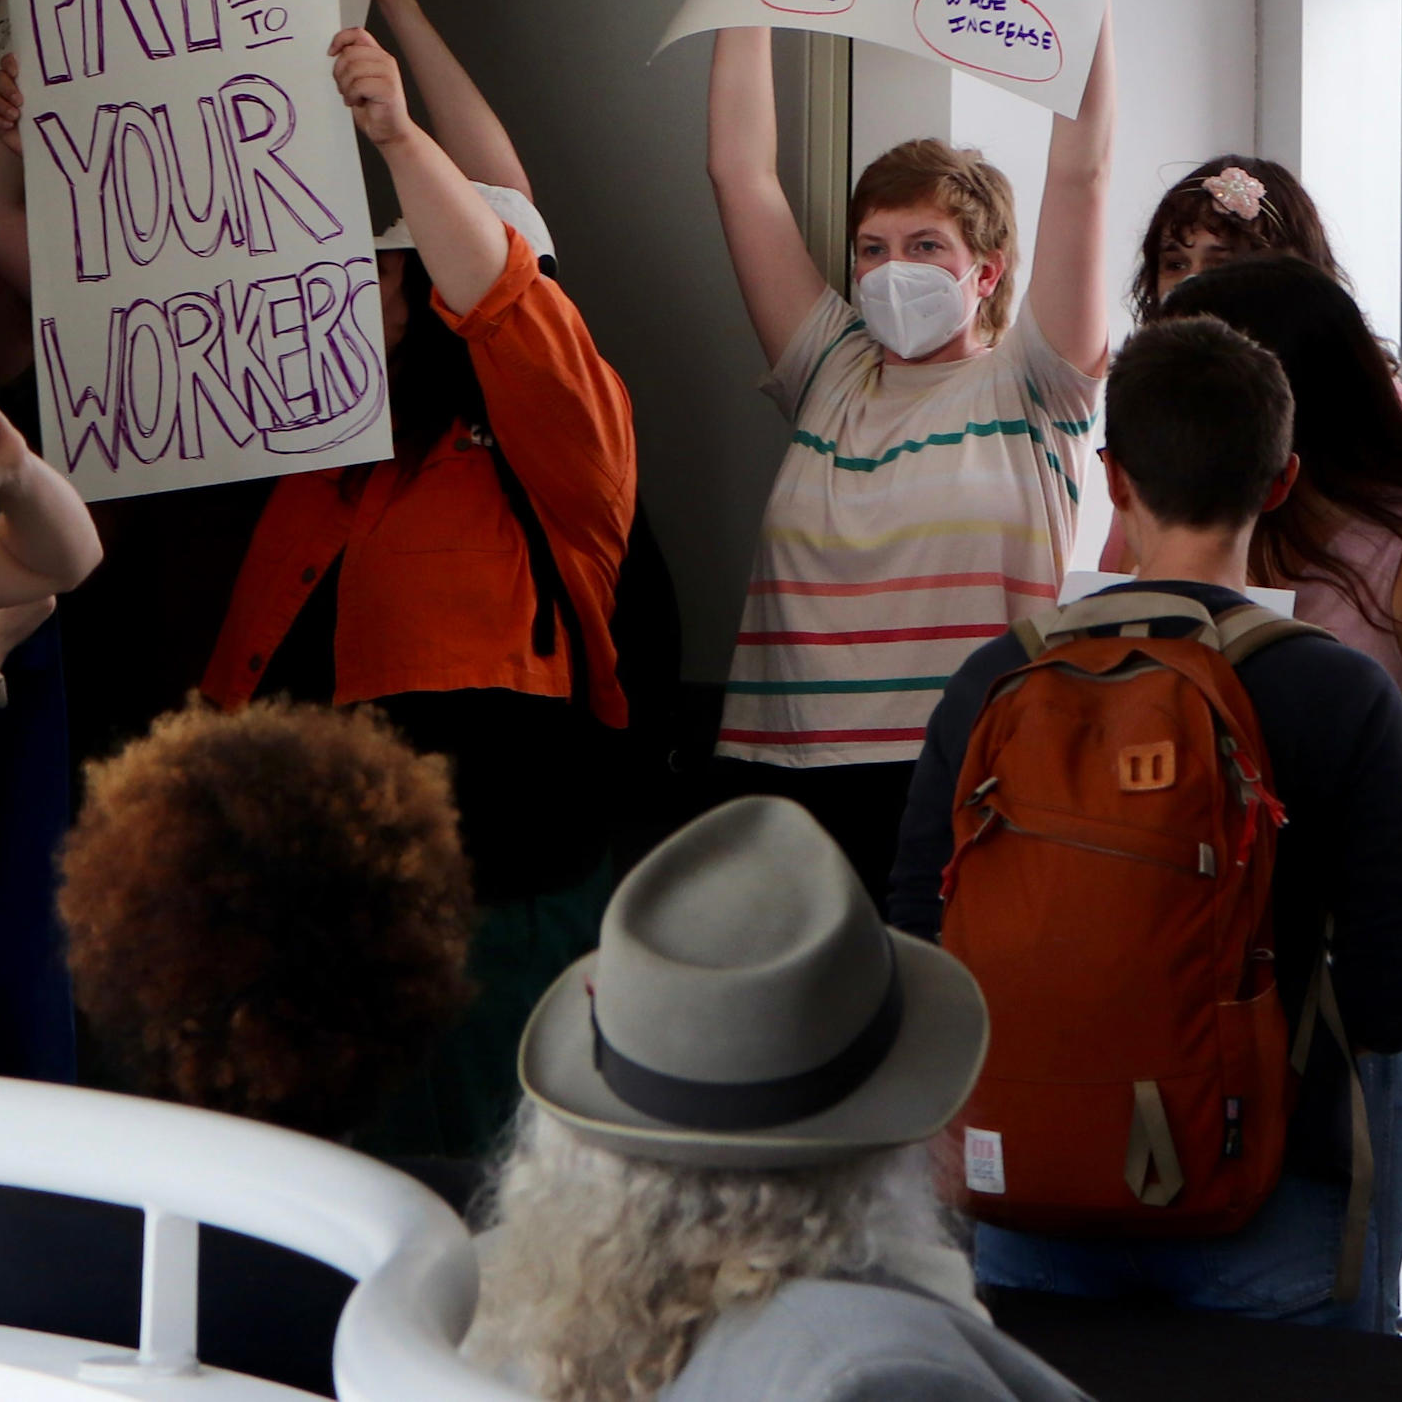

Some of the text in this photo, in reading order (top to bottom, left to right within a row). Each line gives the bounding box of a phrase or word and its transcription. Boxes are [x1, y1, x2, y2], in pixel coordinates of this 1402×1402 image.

[249, 6, 288, 35] TO
[948, 15, 1053, 50] INCREASE
[33, 74, 344, 282] YOUR
[39, 257, 385, 474] WORKERS
